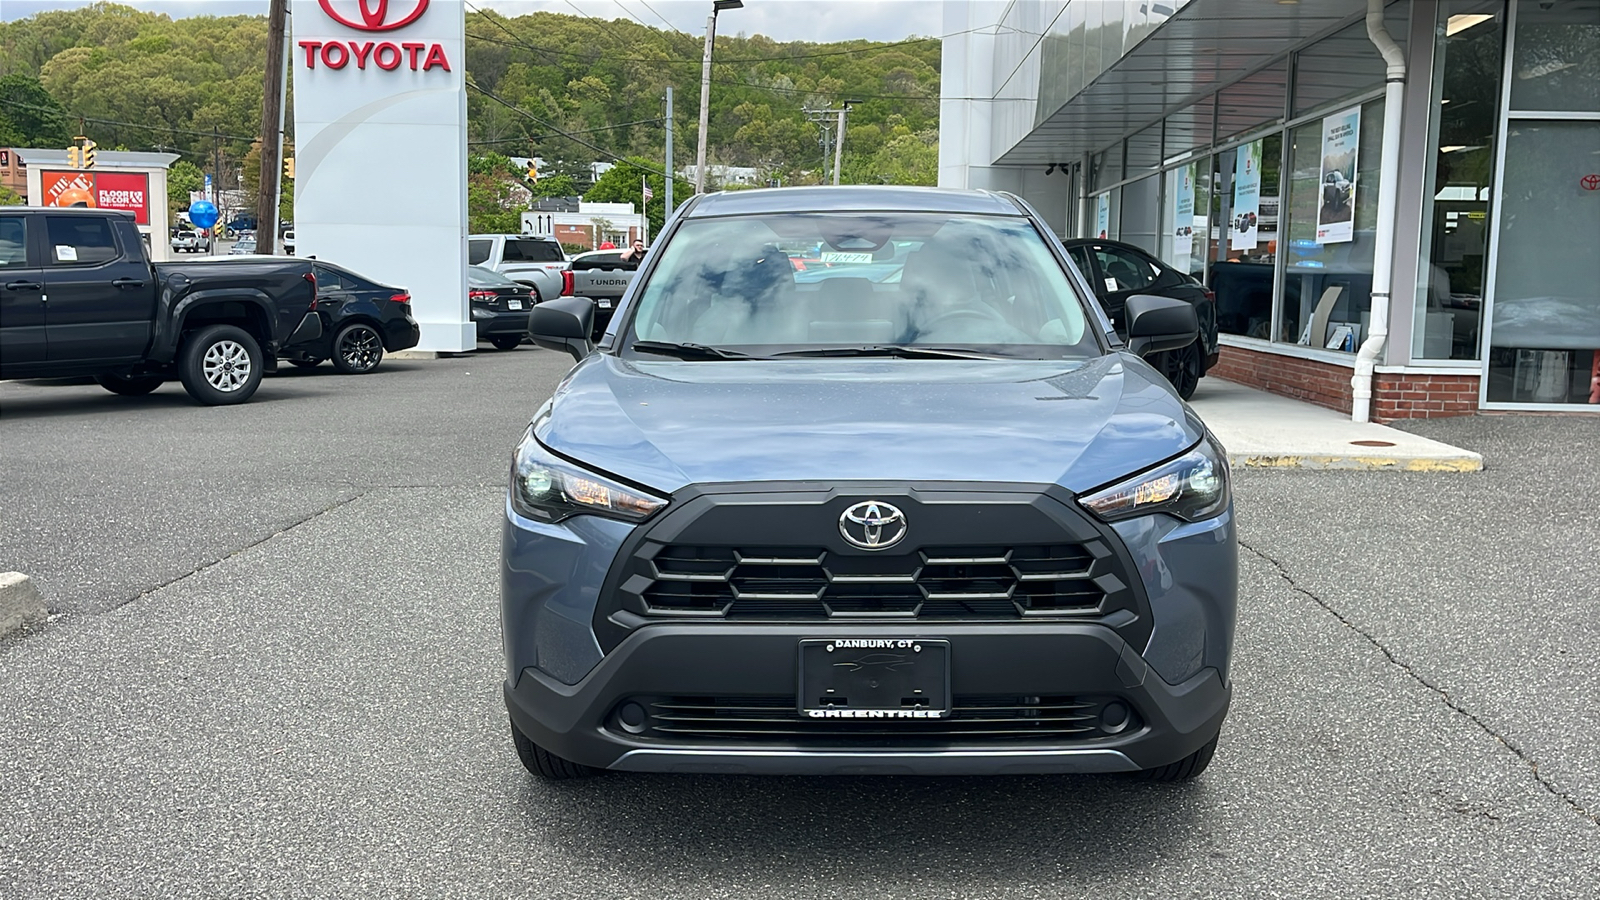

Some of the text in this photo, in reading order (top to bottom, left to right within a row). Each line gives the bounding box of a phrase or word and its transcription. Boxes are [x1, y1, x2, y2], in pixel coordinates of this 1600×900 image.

[298, 41, 452, 72] TOYOTA
[48, 176, 70, 198] THE
[835, 640, 914, 649] DANBURY, CT
[808, 710, 941, 718] GREENTREE
